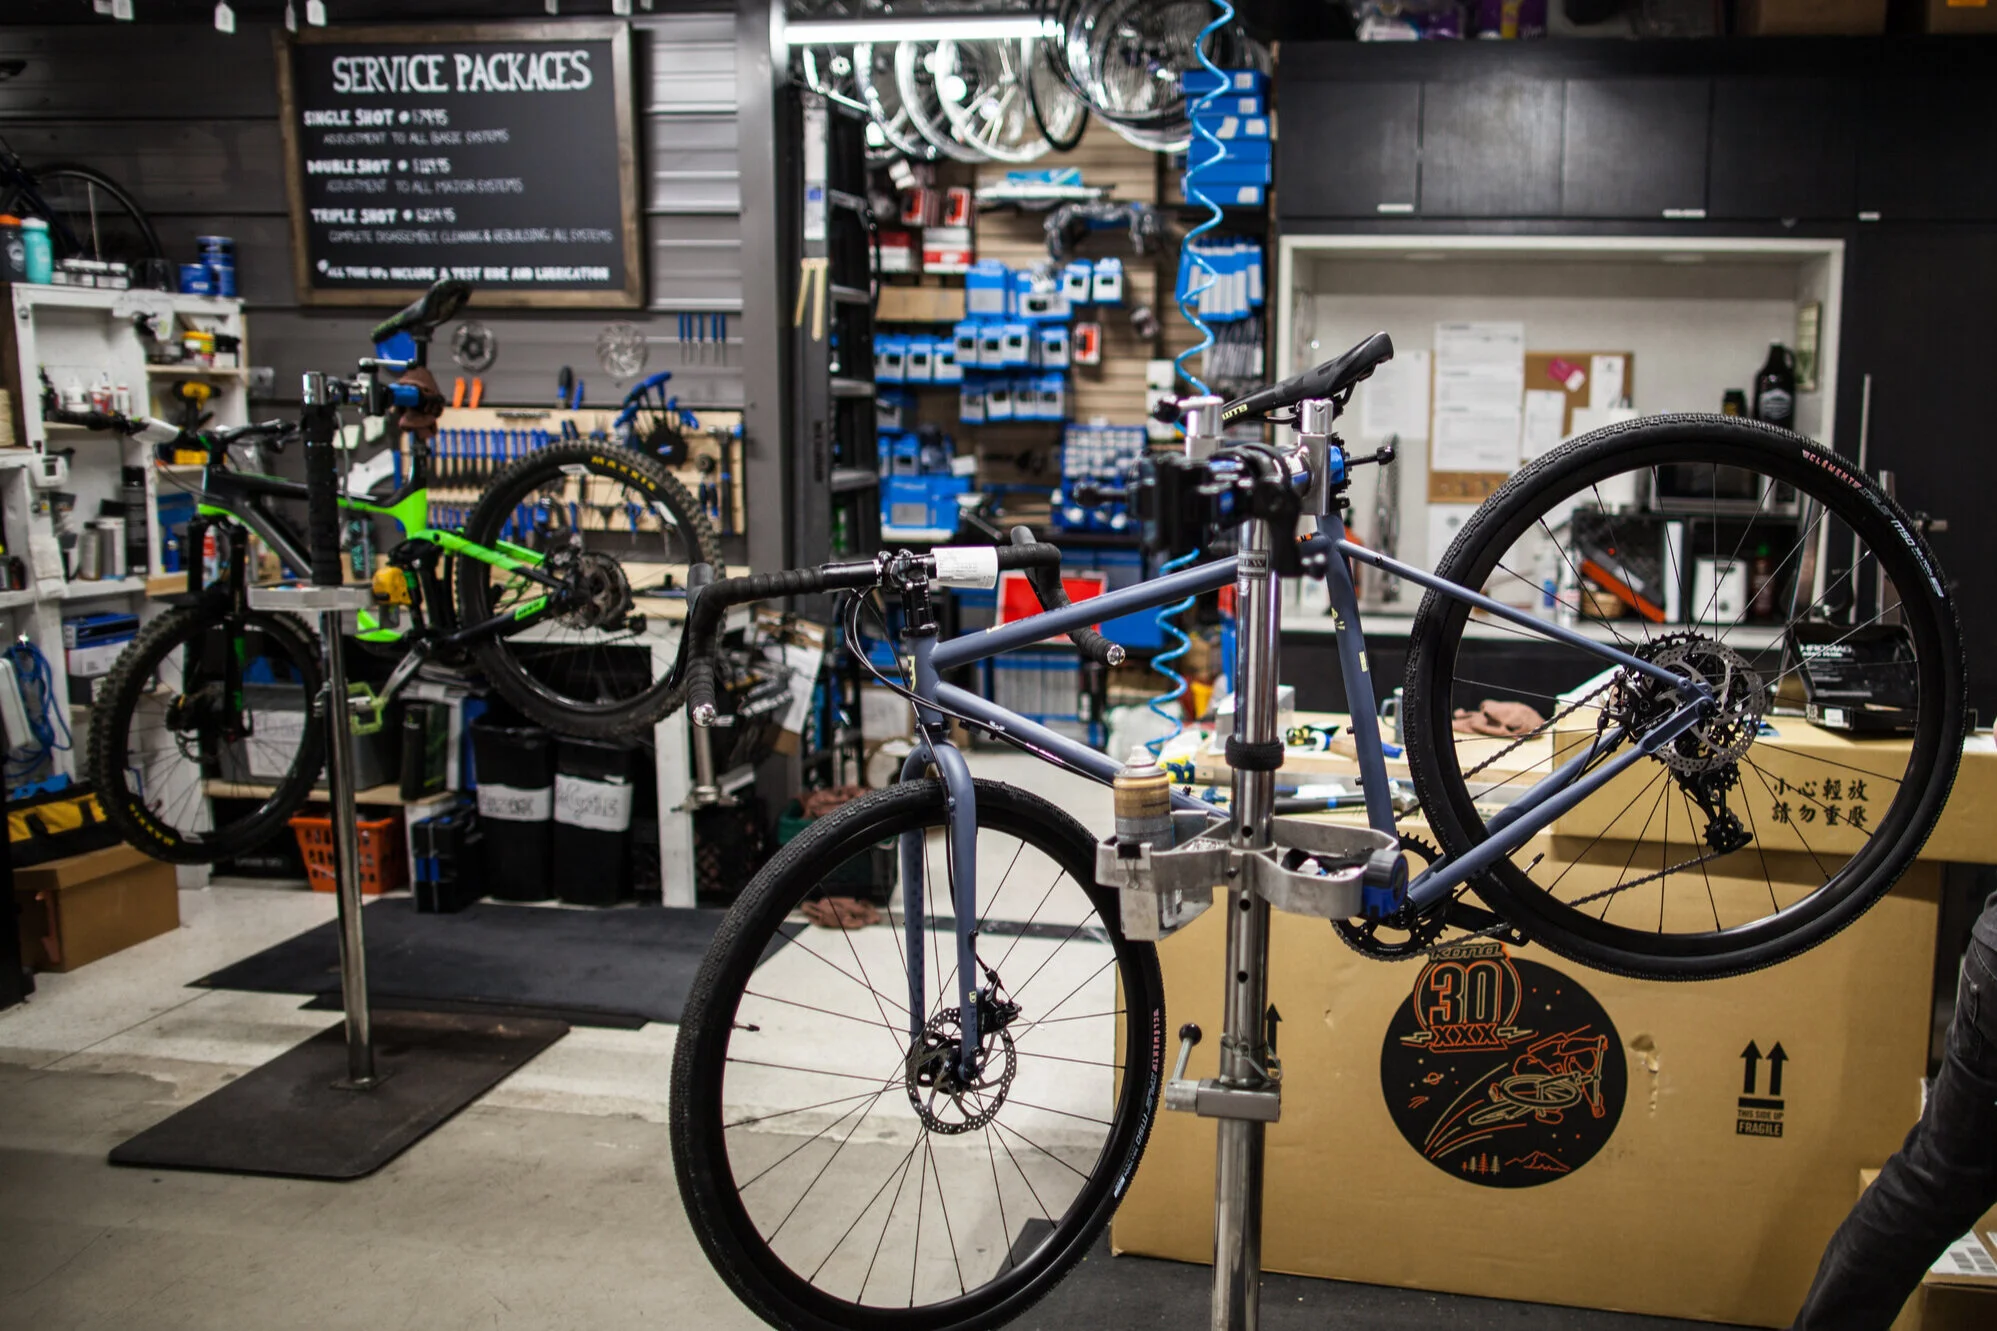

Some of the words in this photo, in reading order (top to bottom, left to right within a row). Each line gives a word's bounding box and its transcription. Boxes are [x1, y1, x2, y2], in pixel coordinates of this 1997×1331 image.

[332, 53, 449, 94] SERVICE
[454, 50, 592, 92] PACKAGES
[304, 109, 351, 127] SINGLE
[355, 108, 394, 126] SHOT
[391, 132, 406, 145] TO
[409, 132, 429, 146] ALL
[464, 128, 509, 145] SYSTEMS
[307, 159, 355, 174] DOUBLE
[356, 159, 391, 174] SHOT
[395, 179, 410, 194] TO
[411, 179, 433, 195] ALL
[476, 177, 524, 194] SYSTEMS
[310, 208, 356, 224] TRIPLE
[360, 208, 397, 224] SHOT
[328, 229, 373, 243] COMPLETE
[570, 228, 614, 243] SYSTEMS
[389, 267, 436, 280] INCLUDE
[450, 267, 481, 280] TEST
[483, 267, 509, 281] RIDE
[511, 267, 534, 281] AND
[534, 266, 610, 281] LUBRICATION
[1222, 403, 1249, 421] WTB
[1808, 452, 1858, 486] CLEMENT
[1773, 776, 1869, 802] 小心輕放
[1772, 801, 1869, 828] 請勿重壓
[1430, 960, 1503, 1025] 30
[1430, 1023, 1500, 1048] XXX
[1738, 1109, 1754, 1118] THIS
[1755, 1110, 1771, 1119] SIDE
[1773, 1112, 1785, 1120] UP
[1738, 1121, 1781, 1136] FRAGILE
